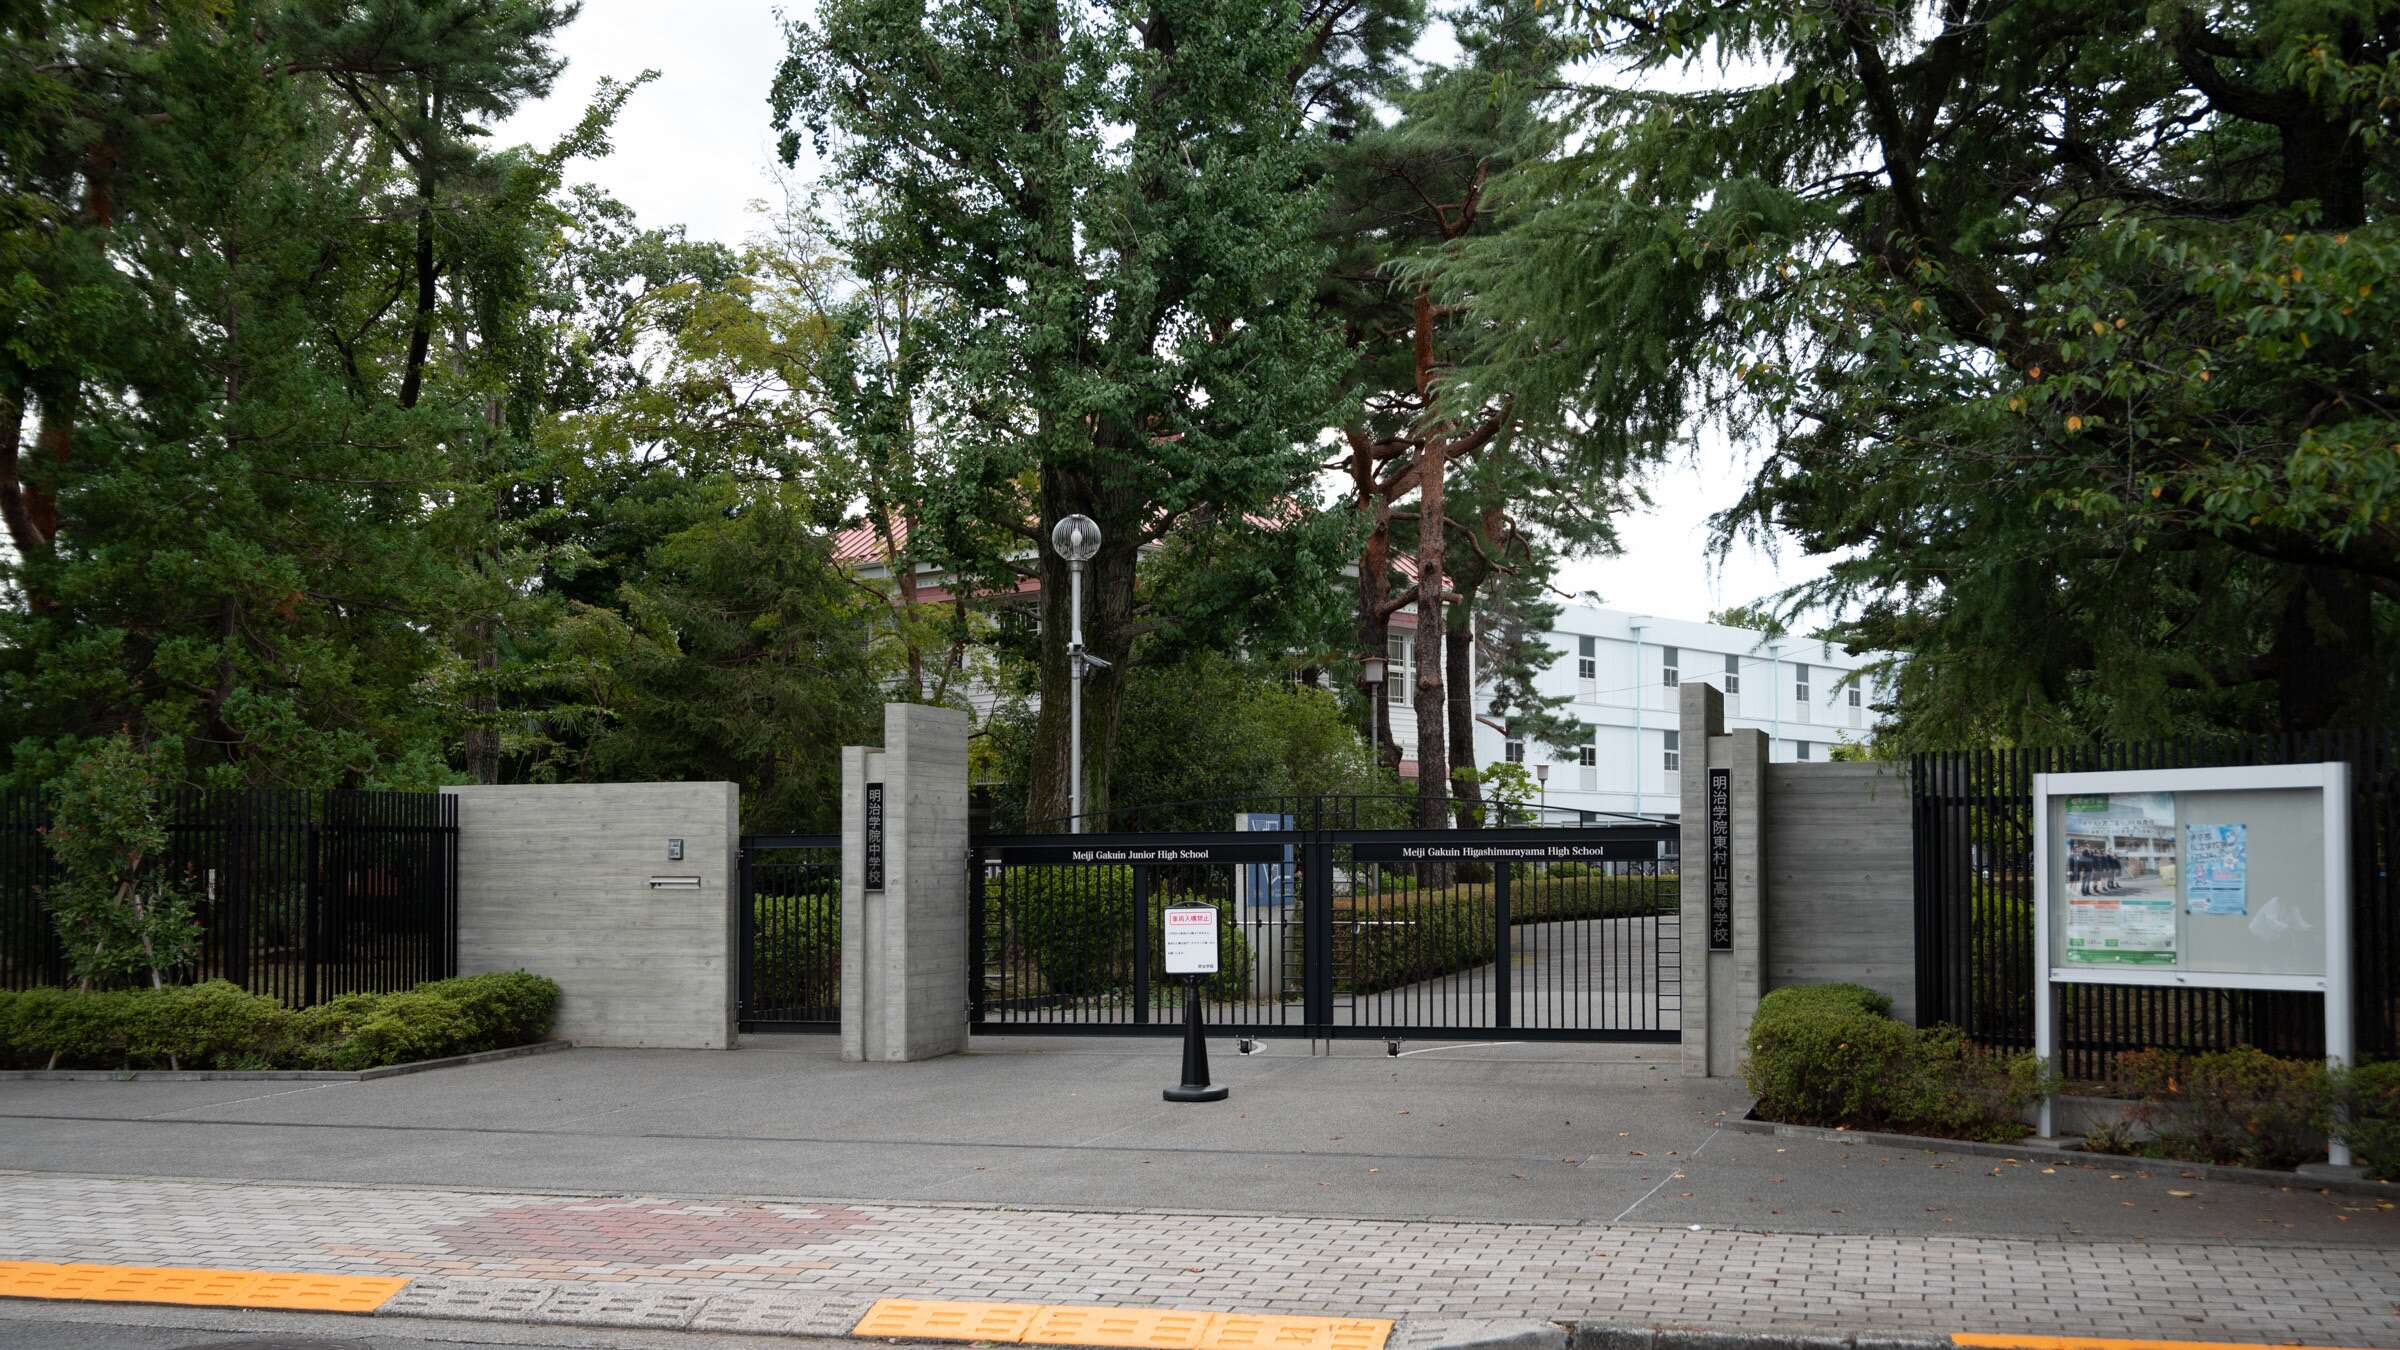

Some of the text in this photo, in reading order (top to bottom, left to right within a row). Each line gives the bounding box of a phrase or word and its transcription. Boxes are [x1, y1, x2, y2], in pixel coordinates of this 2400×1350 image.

[868, 789, 881, 883] 明治学院中学校
[1072, 850, 1209, 861] Meiji Gakuin Junior High School
[1402, 846, 1604, 858] Meiji Gakuin Higashimurayama High School
[1713, 775, 1728, 943] 明治学院東村山高等学校
